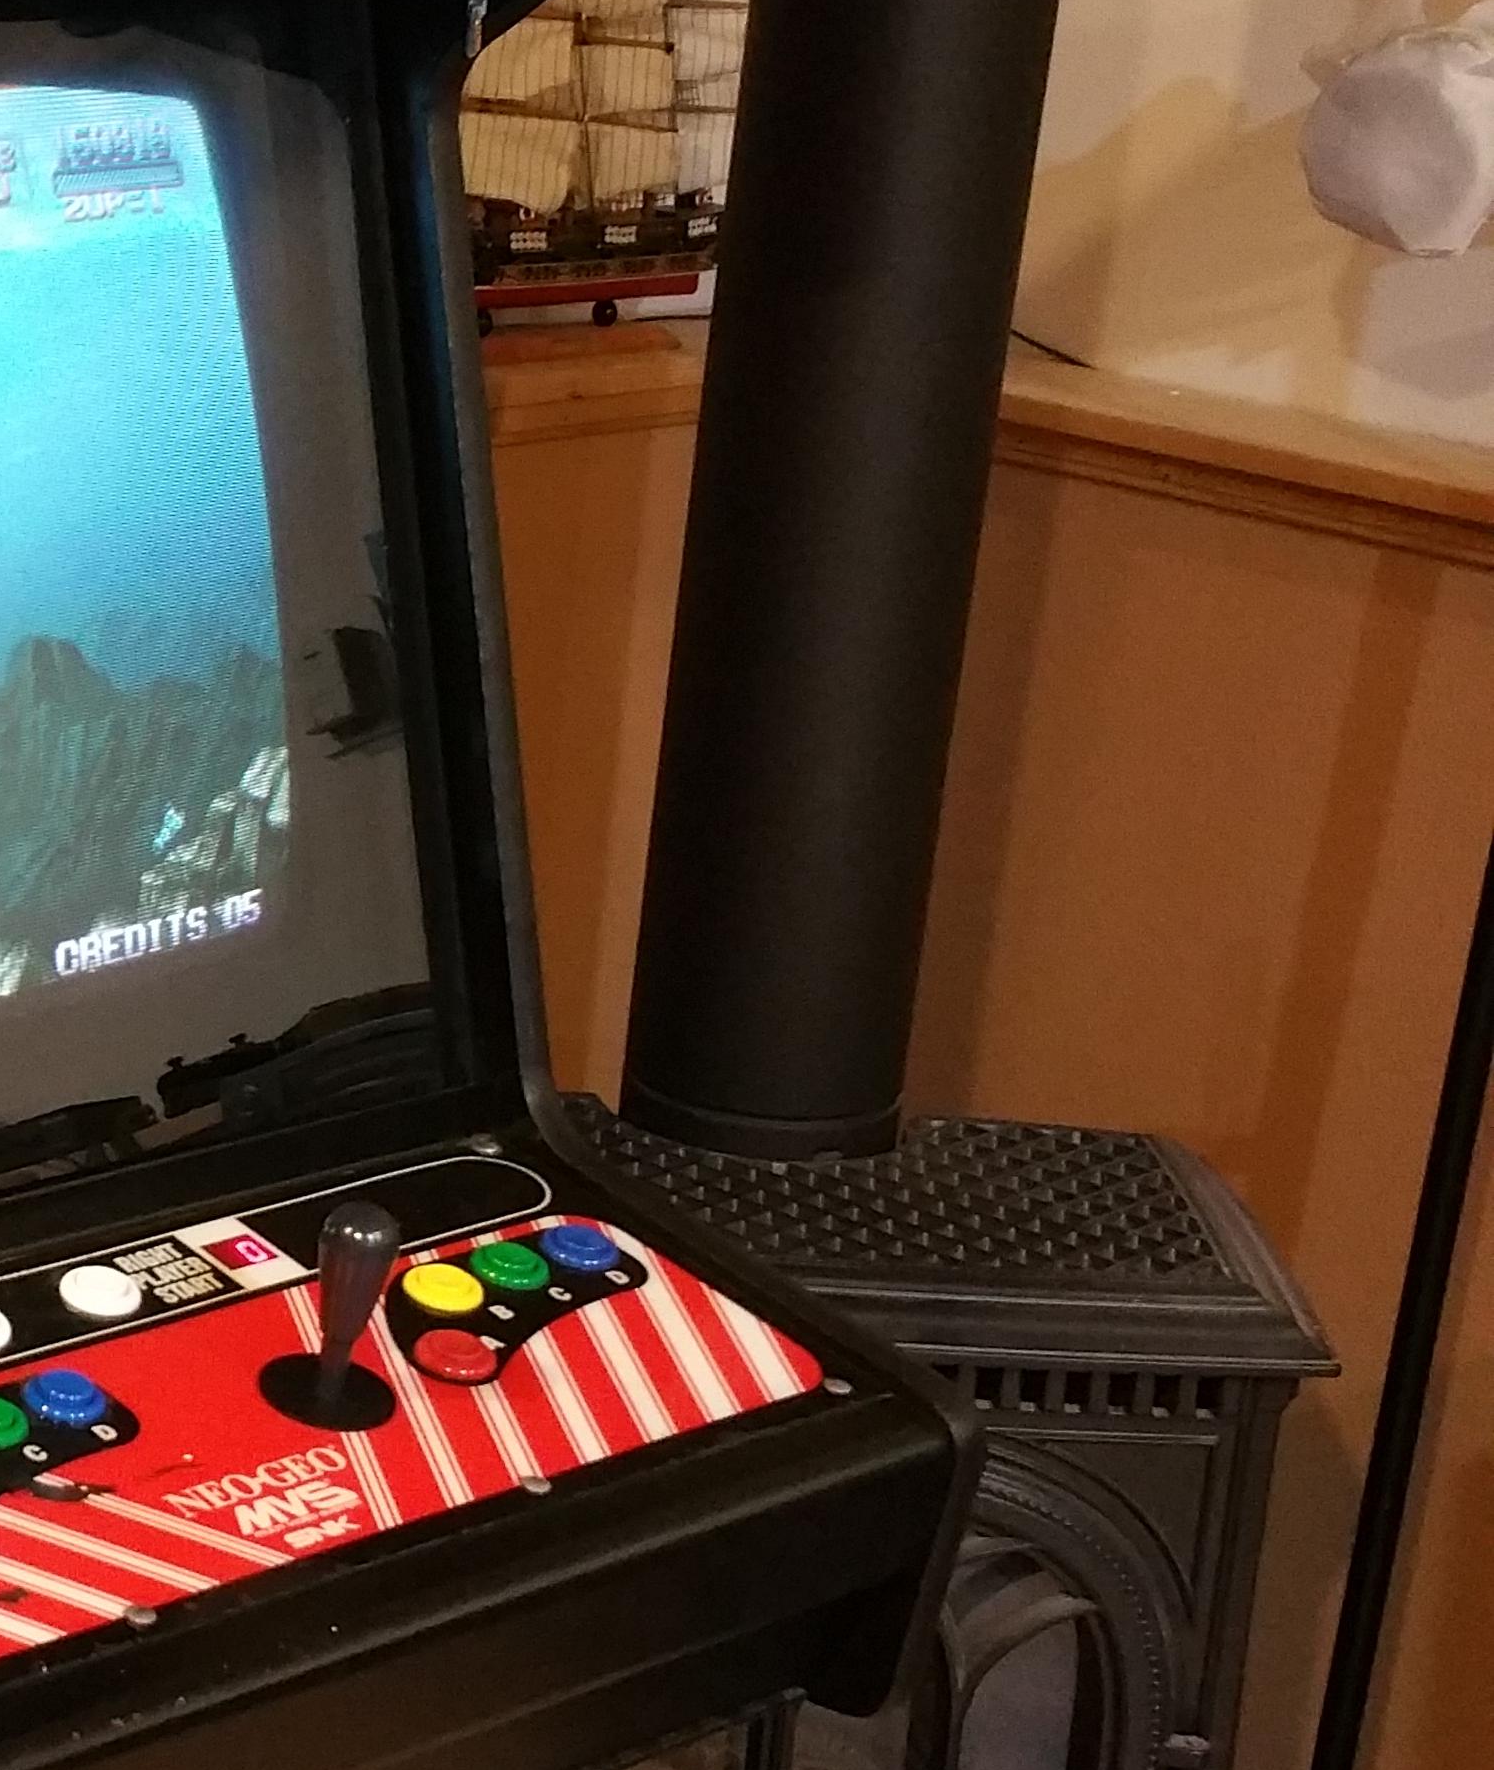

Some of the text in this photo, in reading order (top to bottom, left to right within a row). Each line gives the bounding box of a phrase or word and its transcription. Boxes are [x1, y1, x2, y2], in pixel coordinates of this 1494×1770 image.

[55, 887, 265, 977] CREDITS 05
[112, 1240, 180, 1274] RIGHT
[133, 1255, 212, 1291] PLAYER
[152, 1272, 227, 1306] START
[478, 1269, 631, 1351] A B C D
[22, 1442, 49, 1464] C
[90, 1423, 119, 1442] D
[233, 1479, 360, 1536] MVS
[283, 1515, 363, 1550] SNK
